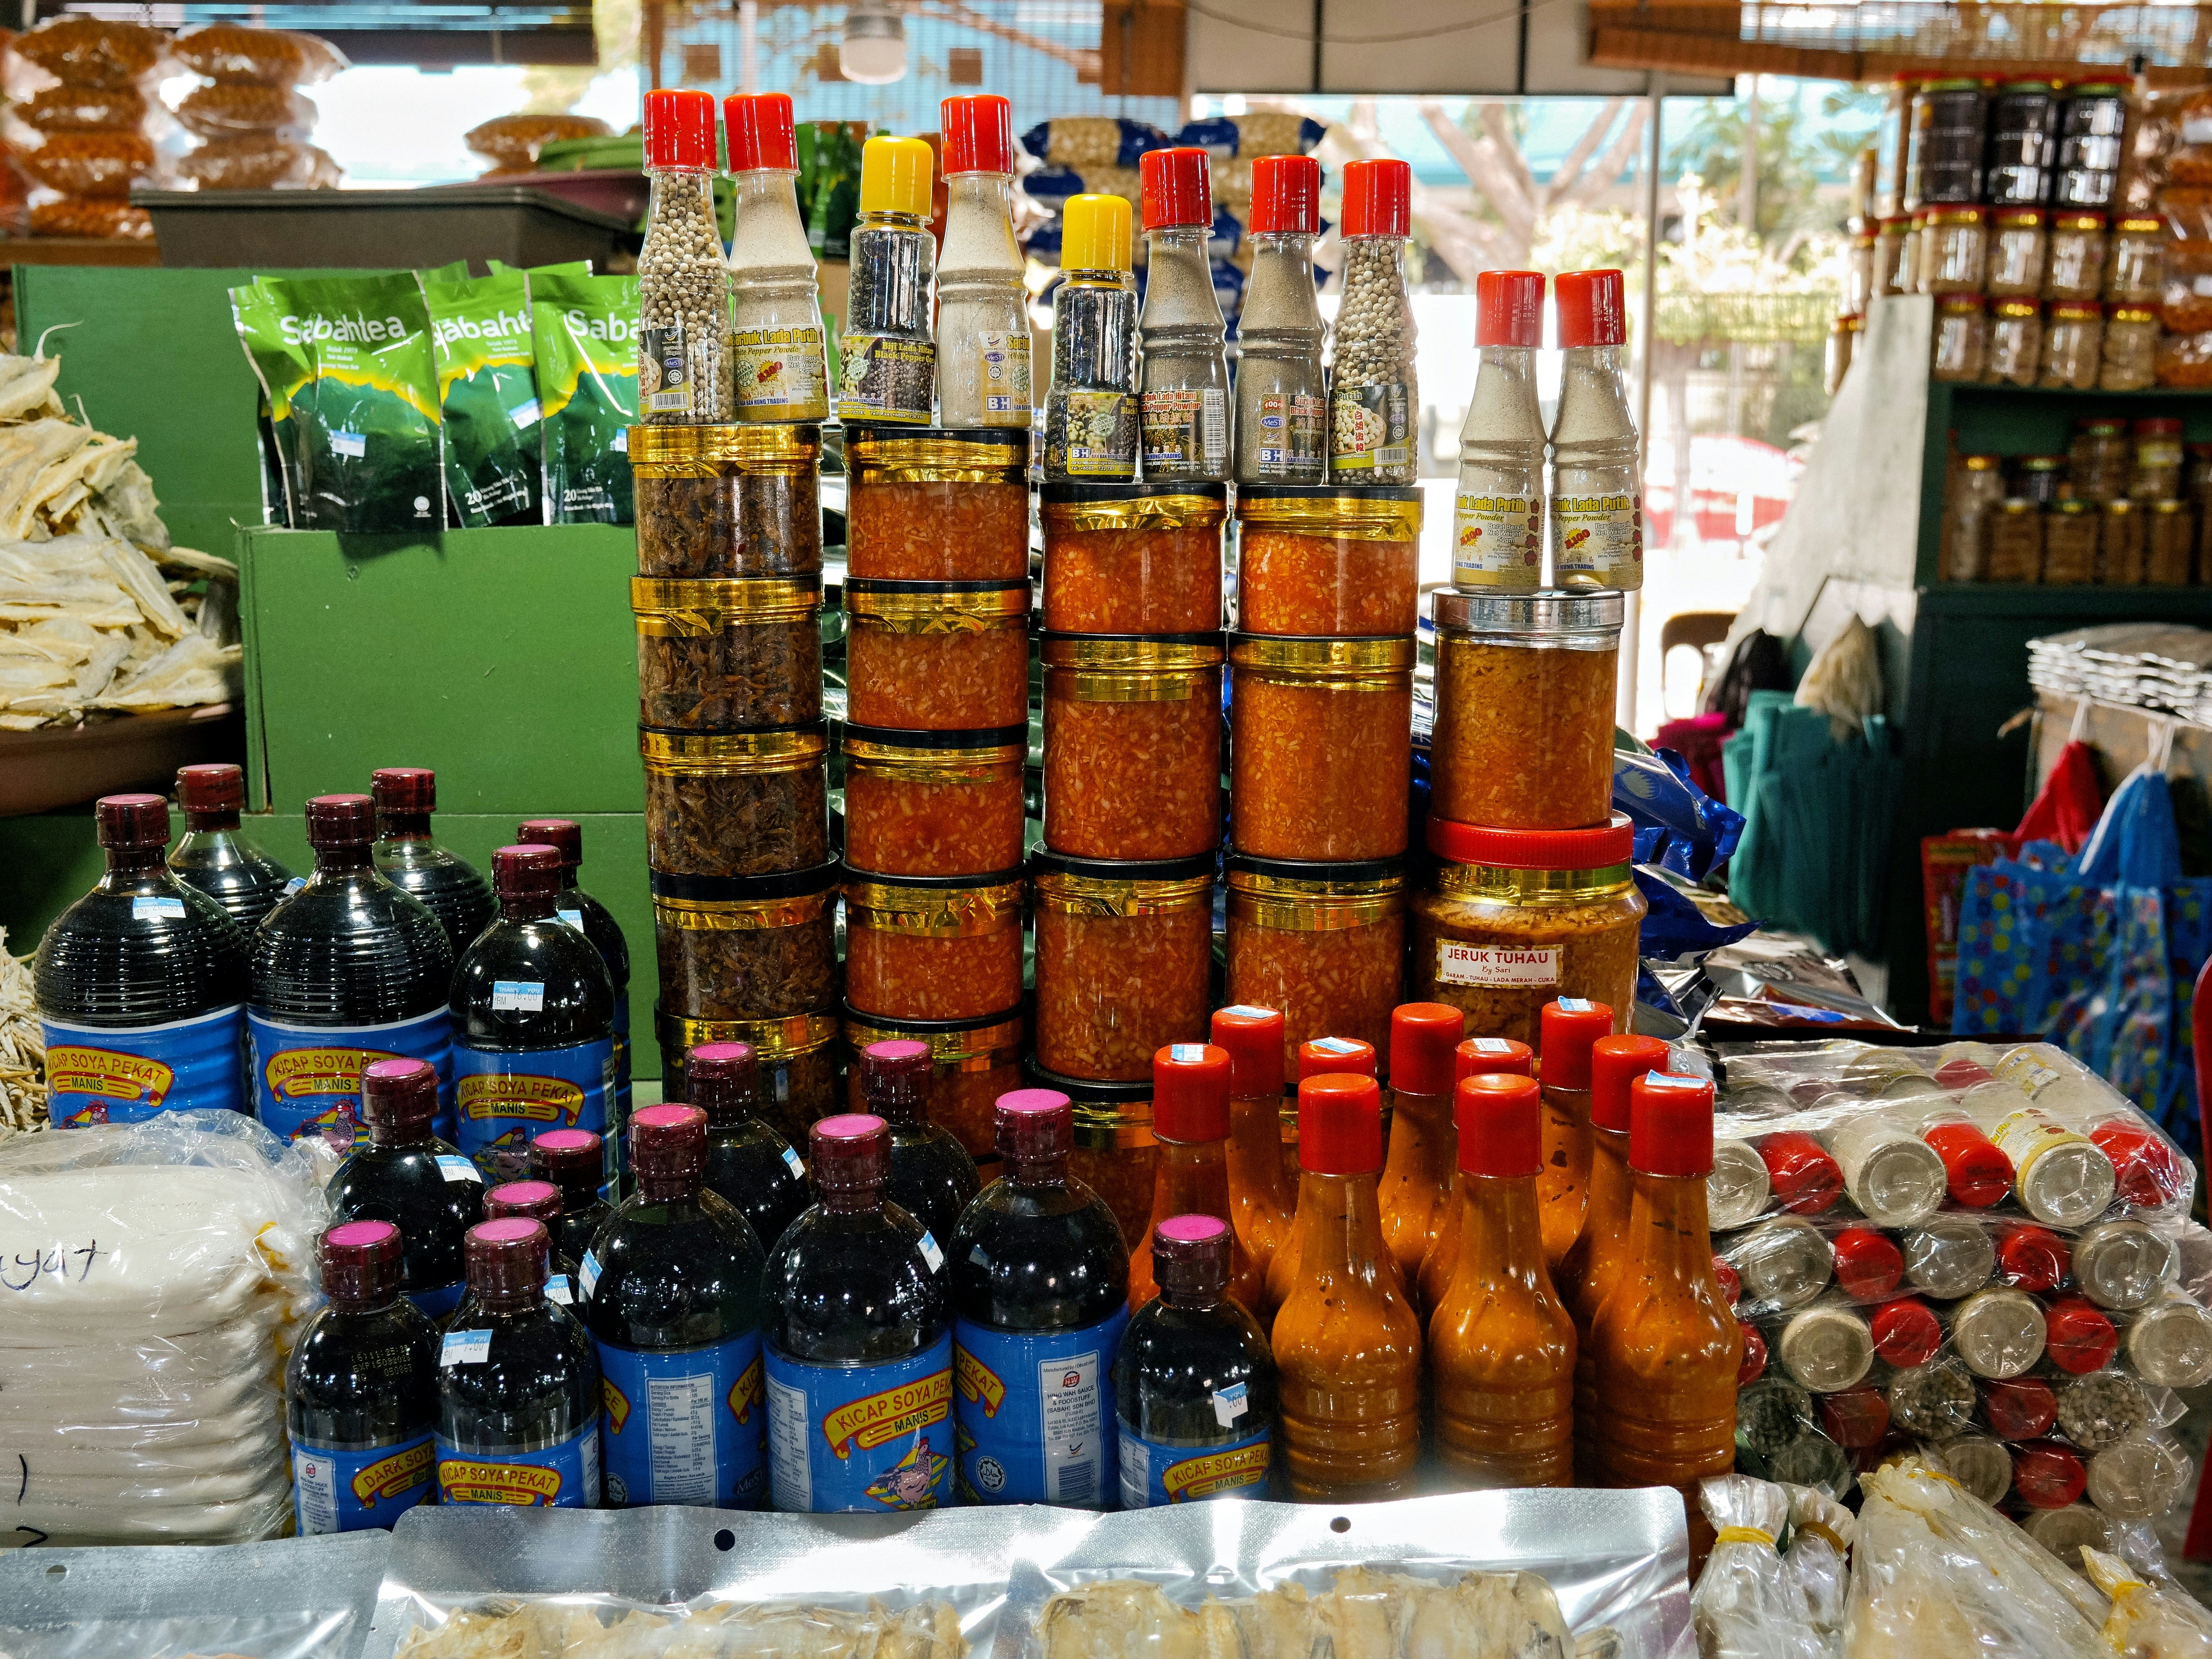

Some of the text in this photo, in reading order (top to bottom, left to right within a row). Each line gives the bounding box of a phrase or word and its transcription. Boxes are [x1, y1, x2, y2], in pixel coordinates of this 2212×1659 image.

[280, 313, 406, 345] Sabahtea
[763, 329, 792, 344] Lada
[792, 328, 818, 343] Putih
[748, 347, 772, 356] Pepper
[882, 342, 934, 355] Biji Lada Hitam
[875, 350, 925, 363] Black Pepper
[1007, 351, 1025, 360] White
[848, 359, 870, 371] SARAWAK
[850, 366, 867, 375] PEPPER
[1159, 391, 1196, 401] Lada Hitam
[1337, 390, 1362, 401] Putih
[1150, 402, 1202, 413] Pepper Powder
[1290, 406, 1307, 415] Black
[1089, 416, 1116, 428] SARAWAK
[465, 491, 482, 505] 20
[564, 490, 576, 501] 20
[1469, 495, 1526, 513] Lada Putih
[1572, 495, 1630, 512] Lada Putih
[1476, 512, 1505, 522] Powder
[1558, 513, 1612, 523] Pepper Powder
[1448, 948, 1548, 964] JERUK TUHAU
[1481, 965, 1492, 975] By
[497, 990, 538, 1005] RM 16.00
[71, 1053, 107, 1071] SOYA
[111, 1058, 165, 1084] PEKAT
[274, 1056, 308, 1078] KICAP
[313, 1055, 355, 1069] SOYA
[72, 1077, 103, 1091] MANIS
[314, 1079, 352, 1090] MANIS
[460, 1080, 577, 1105] KICAP SOYA PEKAT
[491, 1103, 526, 1114] MANIS
[959, 1352, 997, 1393] PEKAT
[1078, 1385, 1095, 1394] SAUCE
[1230, 1390, 1243, 1399] YOU
[1058, 1393, 1091, 1405] FOODSTUFF
[835, 1384, 930, 1432] KICAP SOYA
[1047, 1406, 1071, 1414] (SABAH)
[1085, 1399, 1096, 1407] BHD
[894, 1409, 929, 1433] MANIS
[364, 1458, 403, 1488] DARK
[1172, 1455, 1246, 1485] KICAP SOYA
[442, 1467, 466, 1483] KICAP
[470, 1467, 505, 1483] SOYA
[508, 1470, 555, 1490] PEKAT
[1215, 1474, 1244, 1490] MANIS
[471, 1489, 503, 1501] MANIS
